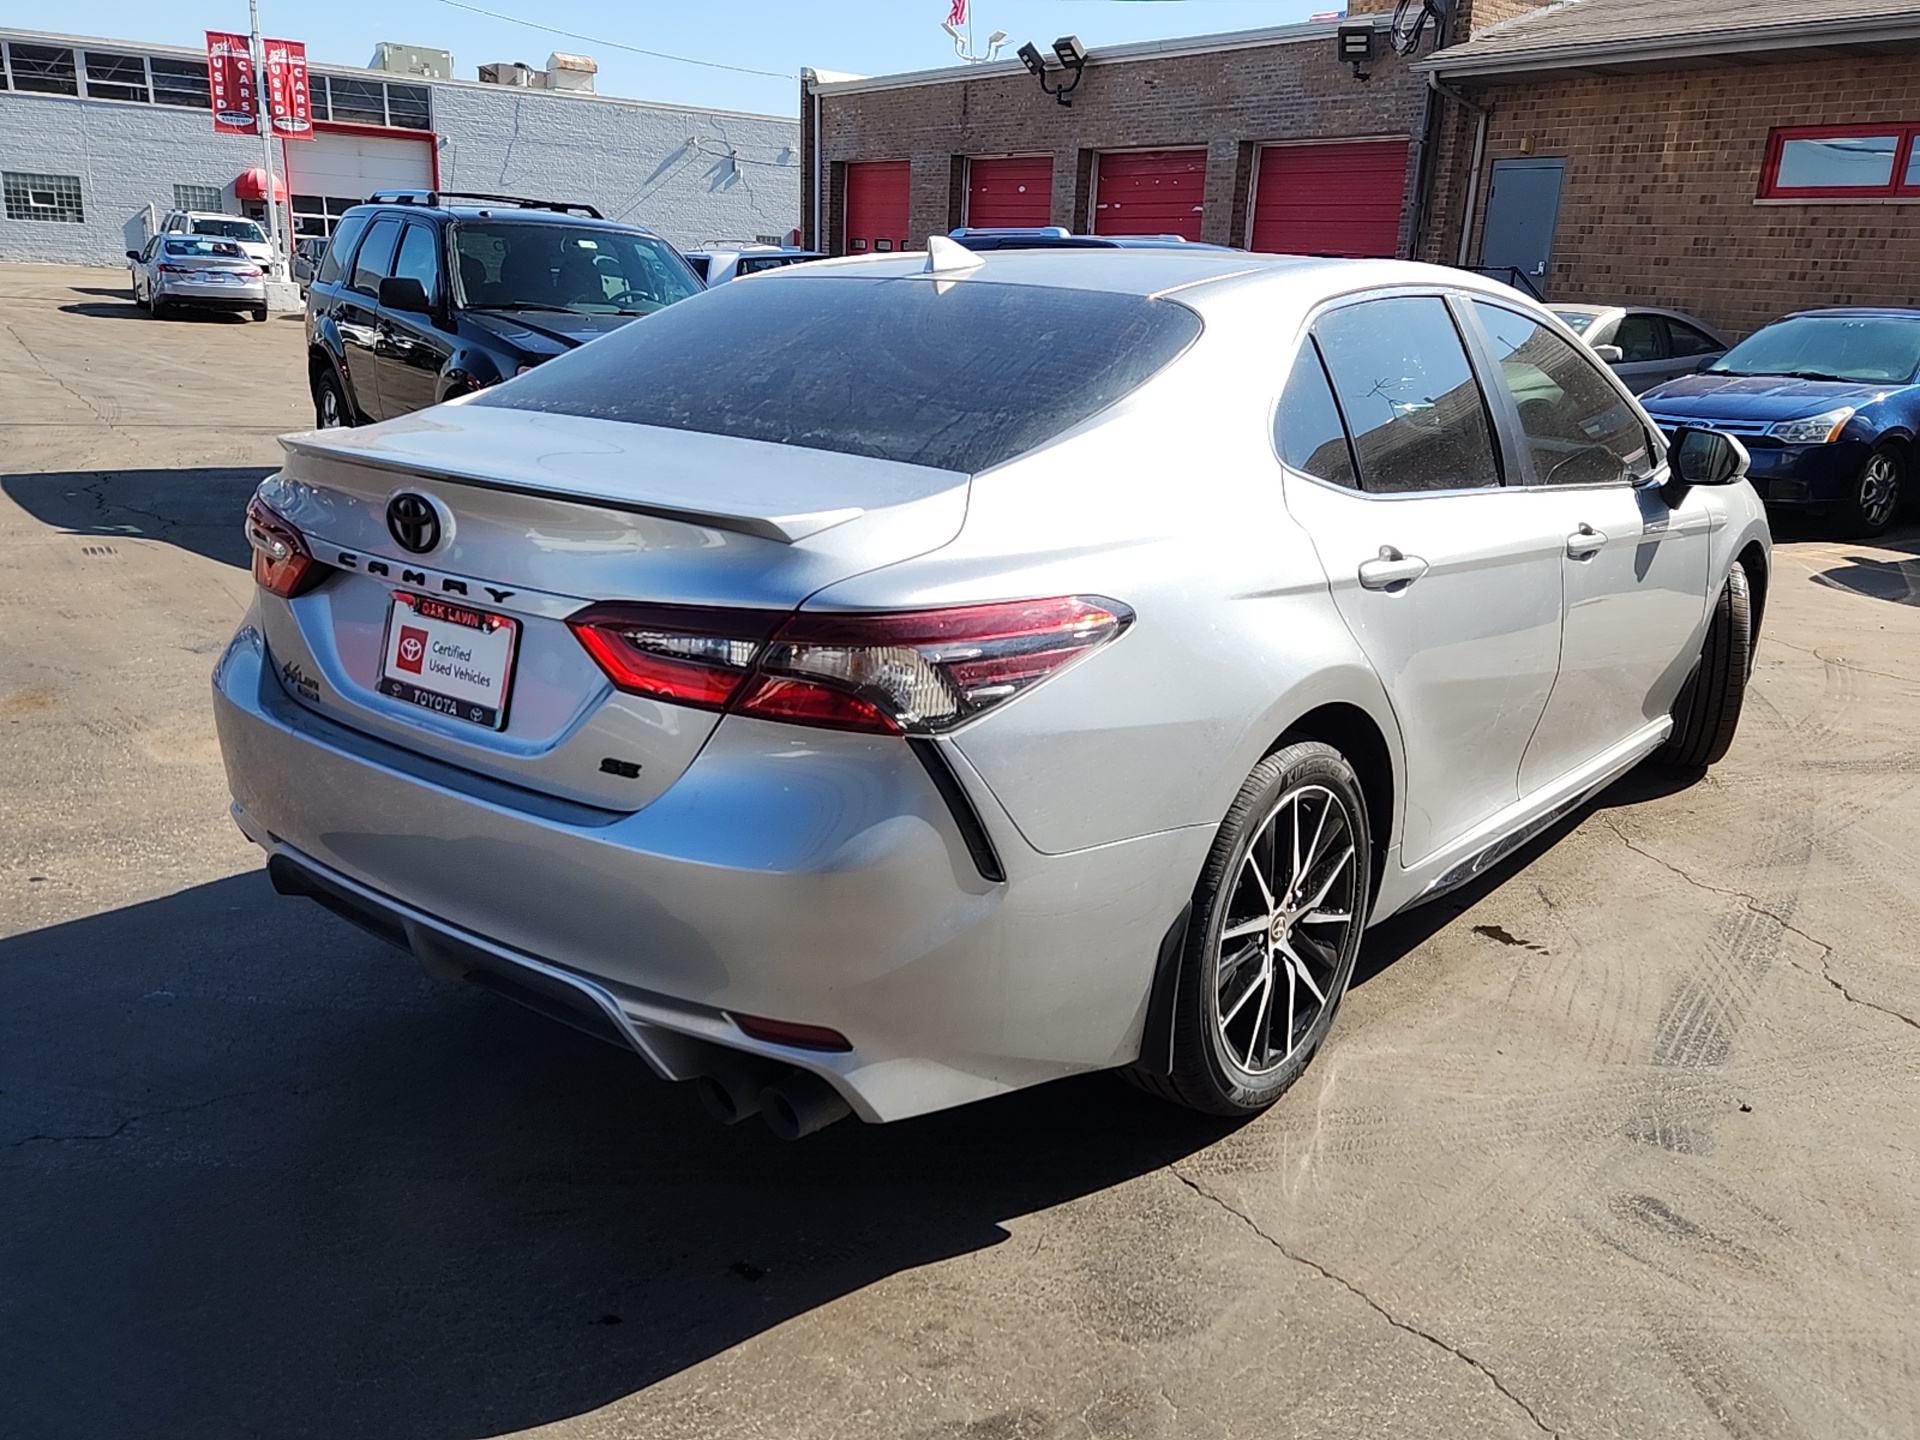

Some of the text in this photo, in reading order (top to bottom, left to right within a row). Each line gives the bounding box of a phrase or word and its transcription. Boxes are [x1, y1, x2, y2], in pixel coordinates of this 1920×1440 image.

[213, 58, 228, 109] USED
[237, 61, 250, 111] CARS
[271, 64, 285, 115] USED
[293, 68, 306, 117] CARS
[338, 551, 516, 603] CAMRY
[421, 602, 480, 627] OAK LAWN
[429, 658, 491, 688] Used Vehicles
[432, 640, 472, 662] Certified
[413, 689, 457, 715] TOYOTA
